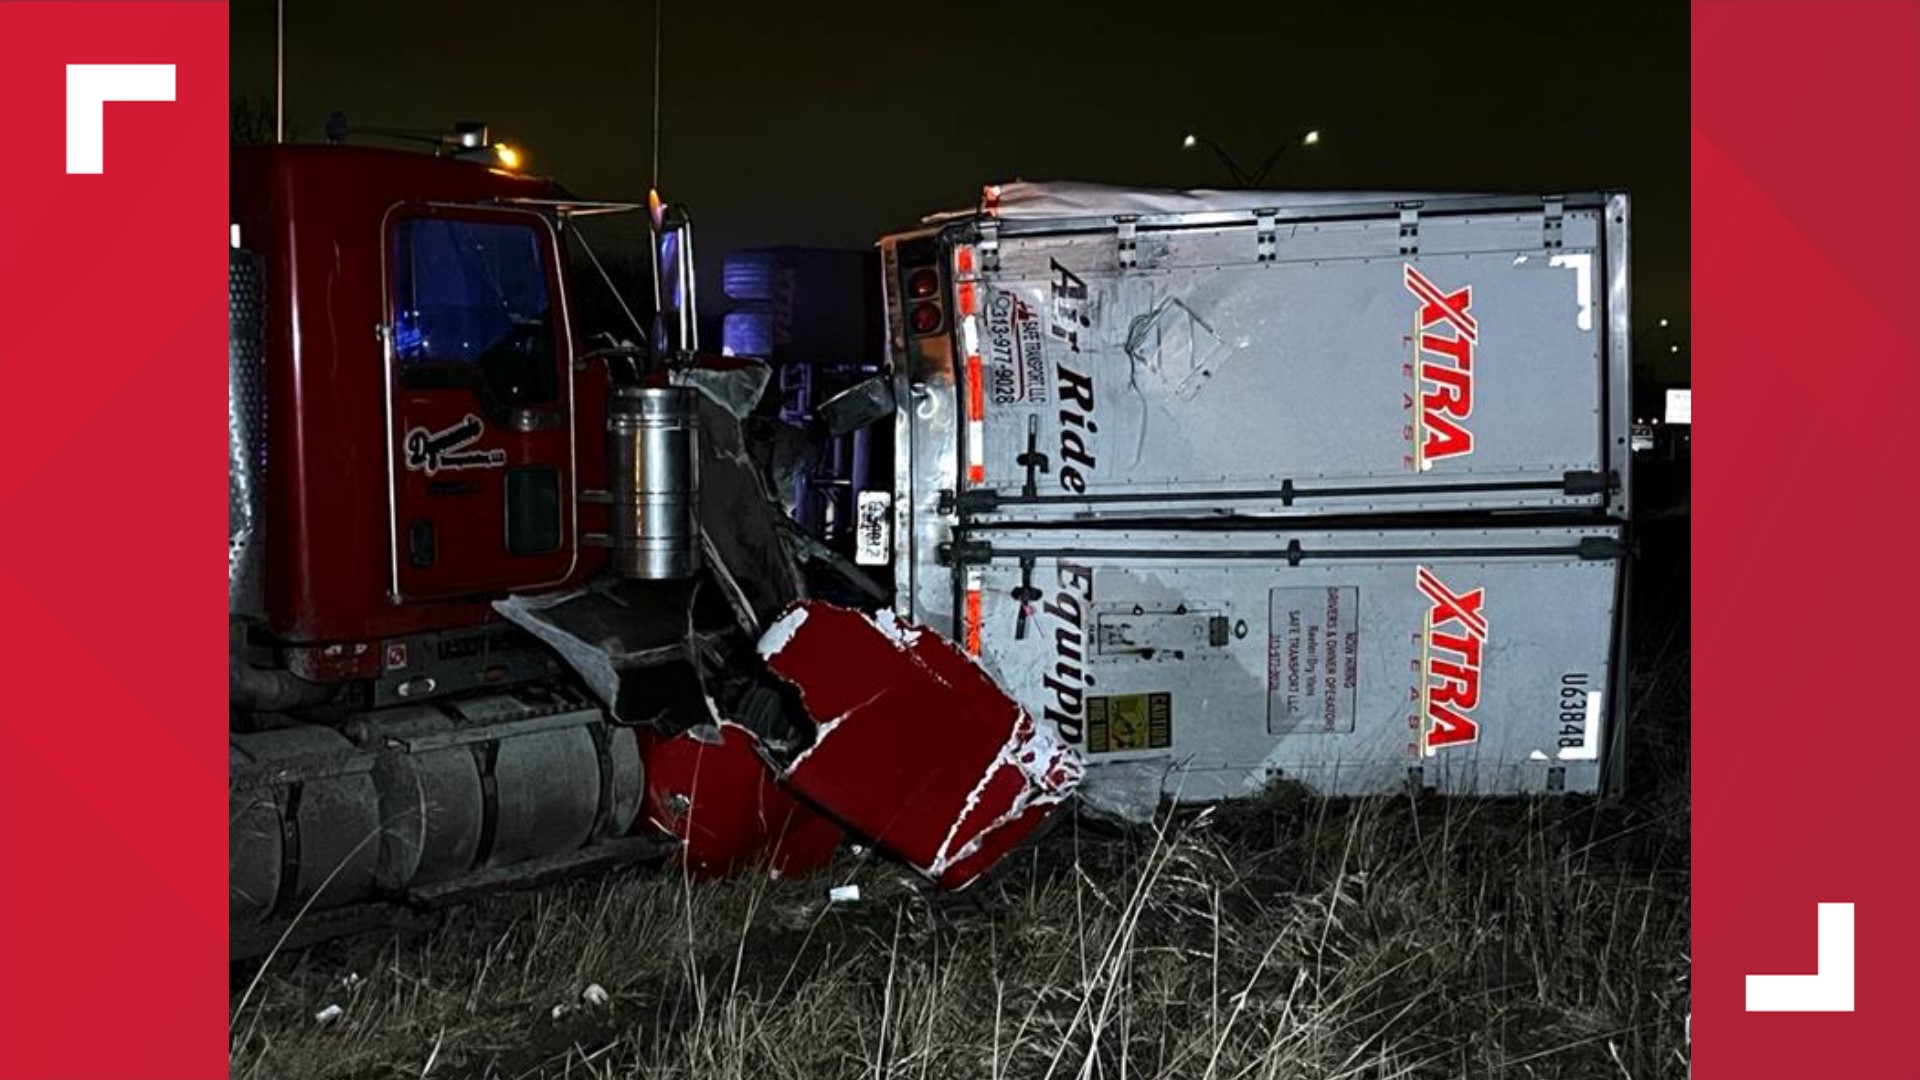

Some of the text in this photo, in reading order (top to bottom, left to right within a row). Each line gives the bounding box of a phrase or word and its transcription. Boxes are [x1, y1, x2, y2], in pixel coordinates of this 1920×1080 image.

[991, 308, 1015, 404] 313-977-9028
[1022, 320, 1041, 341] SAFE
[1404, 262, 1478, 460] XTRA
[1029, 388, 1046, 403] LLC
[1402, 335, 1414, 470] LEASE
[1043, 256, 1098, 745] Air Ride Equipp
[1287, 609, 1301, 713] SAFE TRANSPORT LLC
[1407, 632, 1421, 755] LEASE
[1416, 565, 1488, 748] XTRA
[1557, 673, 1589, 748] U63848
